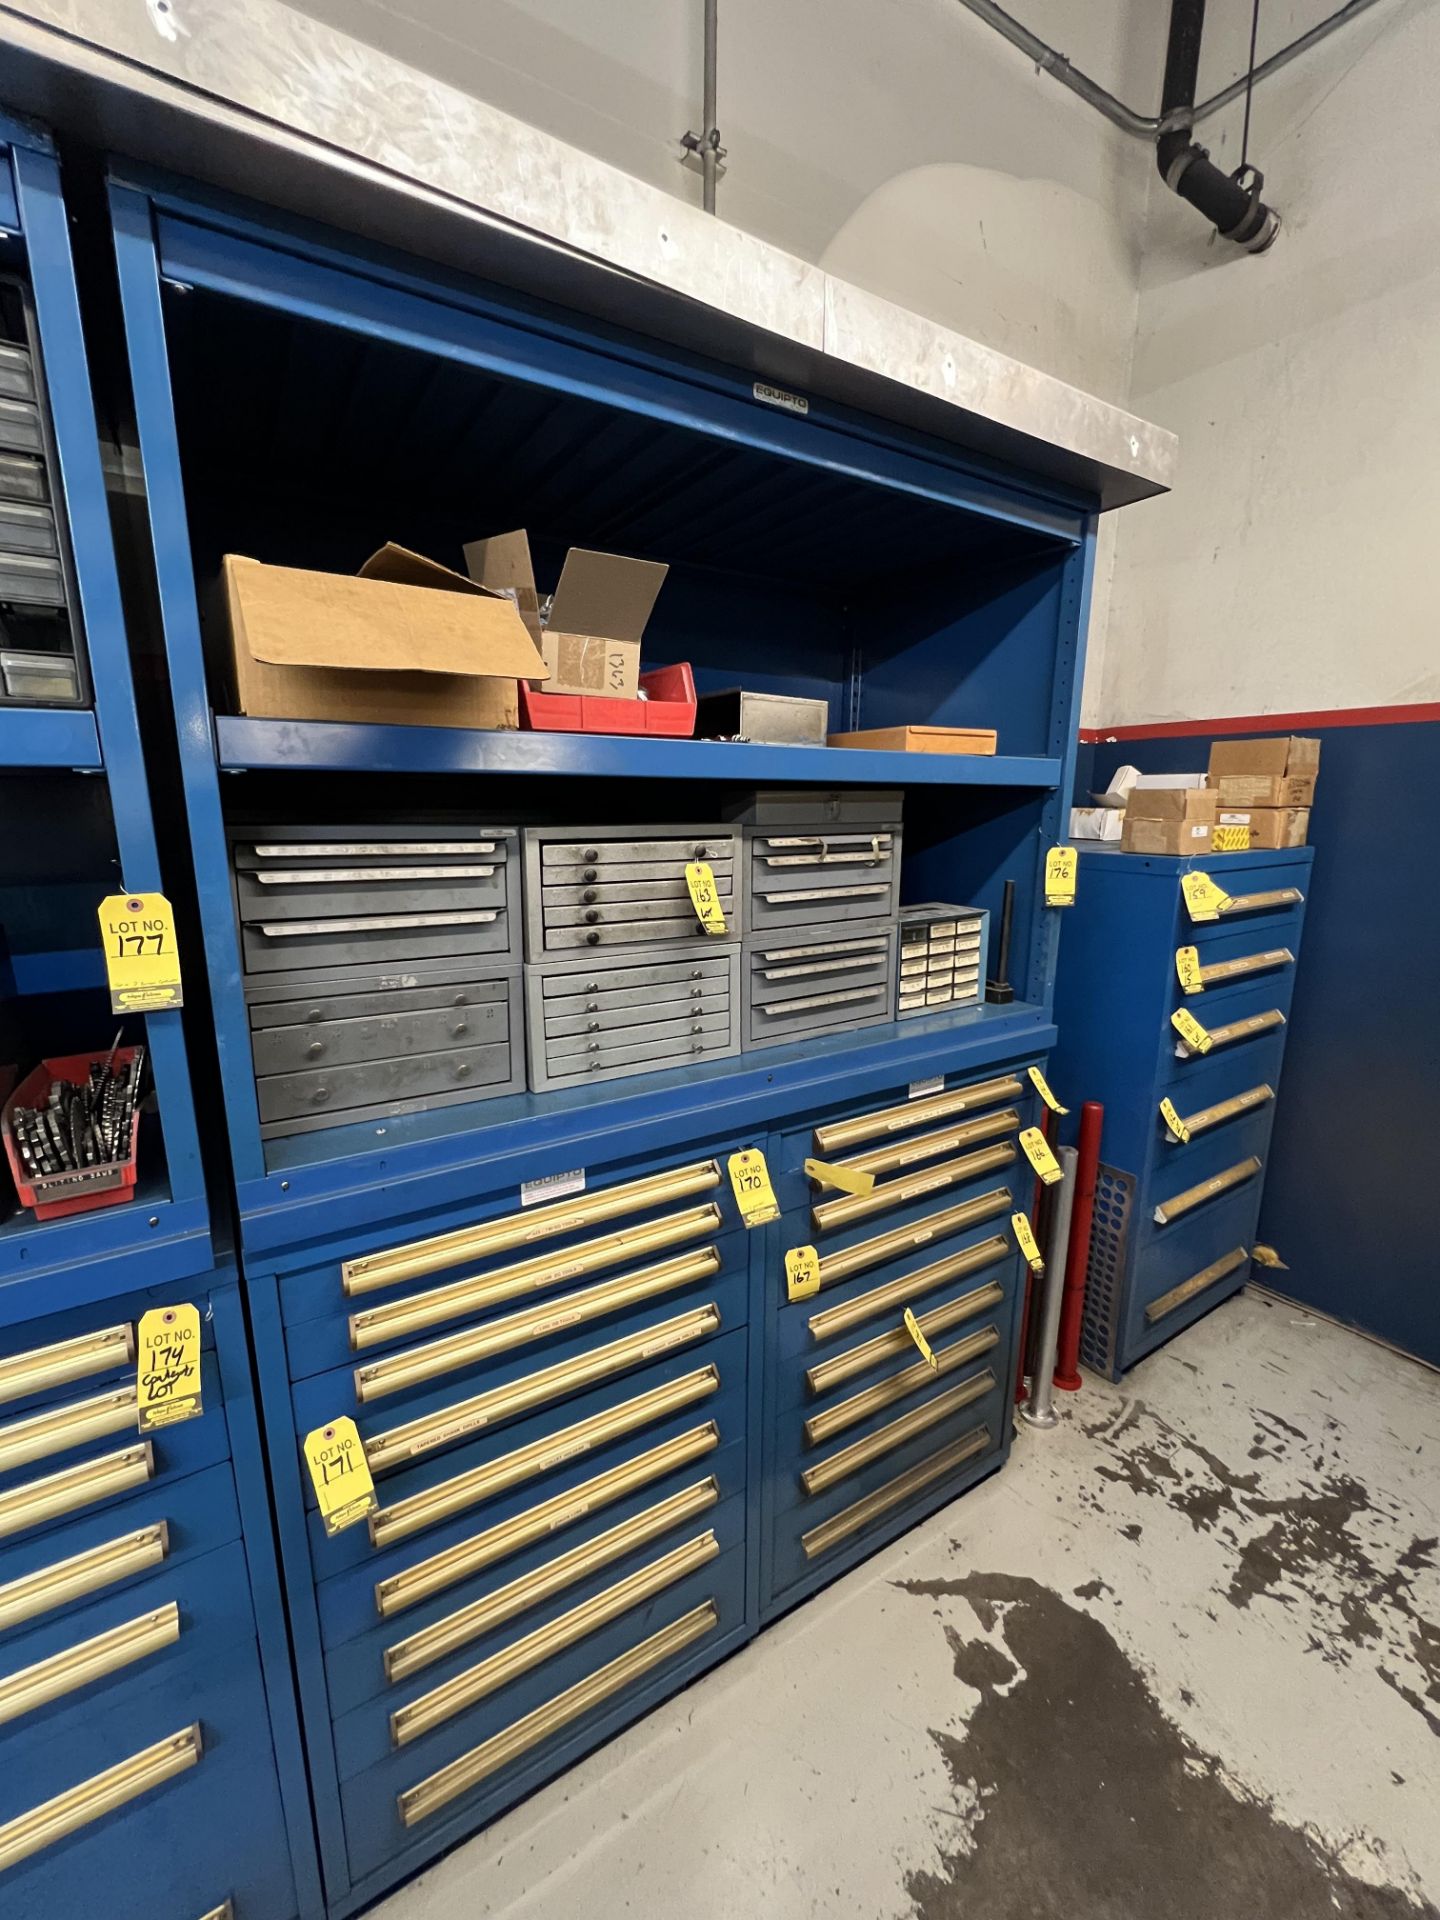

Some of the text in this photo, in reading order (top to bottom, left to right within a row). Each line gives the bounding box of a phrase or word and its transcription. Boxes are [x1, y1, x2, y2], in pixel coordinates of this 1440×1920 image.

[756, 385, 807, 408] EQUIPTO
[1049, 867, 1069, 879] 176
[695, 888, 711, 902] 163
[109, 919, 168, 934] LOT NO.
[118, 933, 164, 957] 177
[734, 1168, 748, 1179] LOT
[739, 1176, 762, 1192] 170
[790, 1263, 802, 1273] LOT
[793, 1271, 810, 1284] 167
[146, 1328, 196, 1349] LOT NO.
[152, 1344, 185, 1371] 174
[313, 1438, 356, 1466] LOT NO.
[322, 1451, 353, 1486] 171
